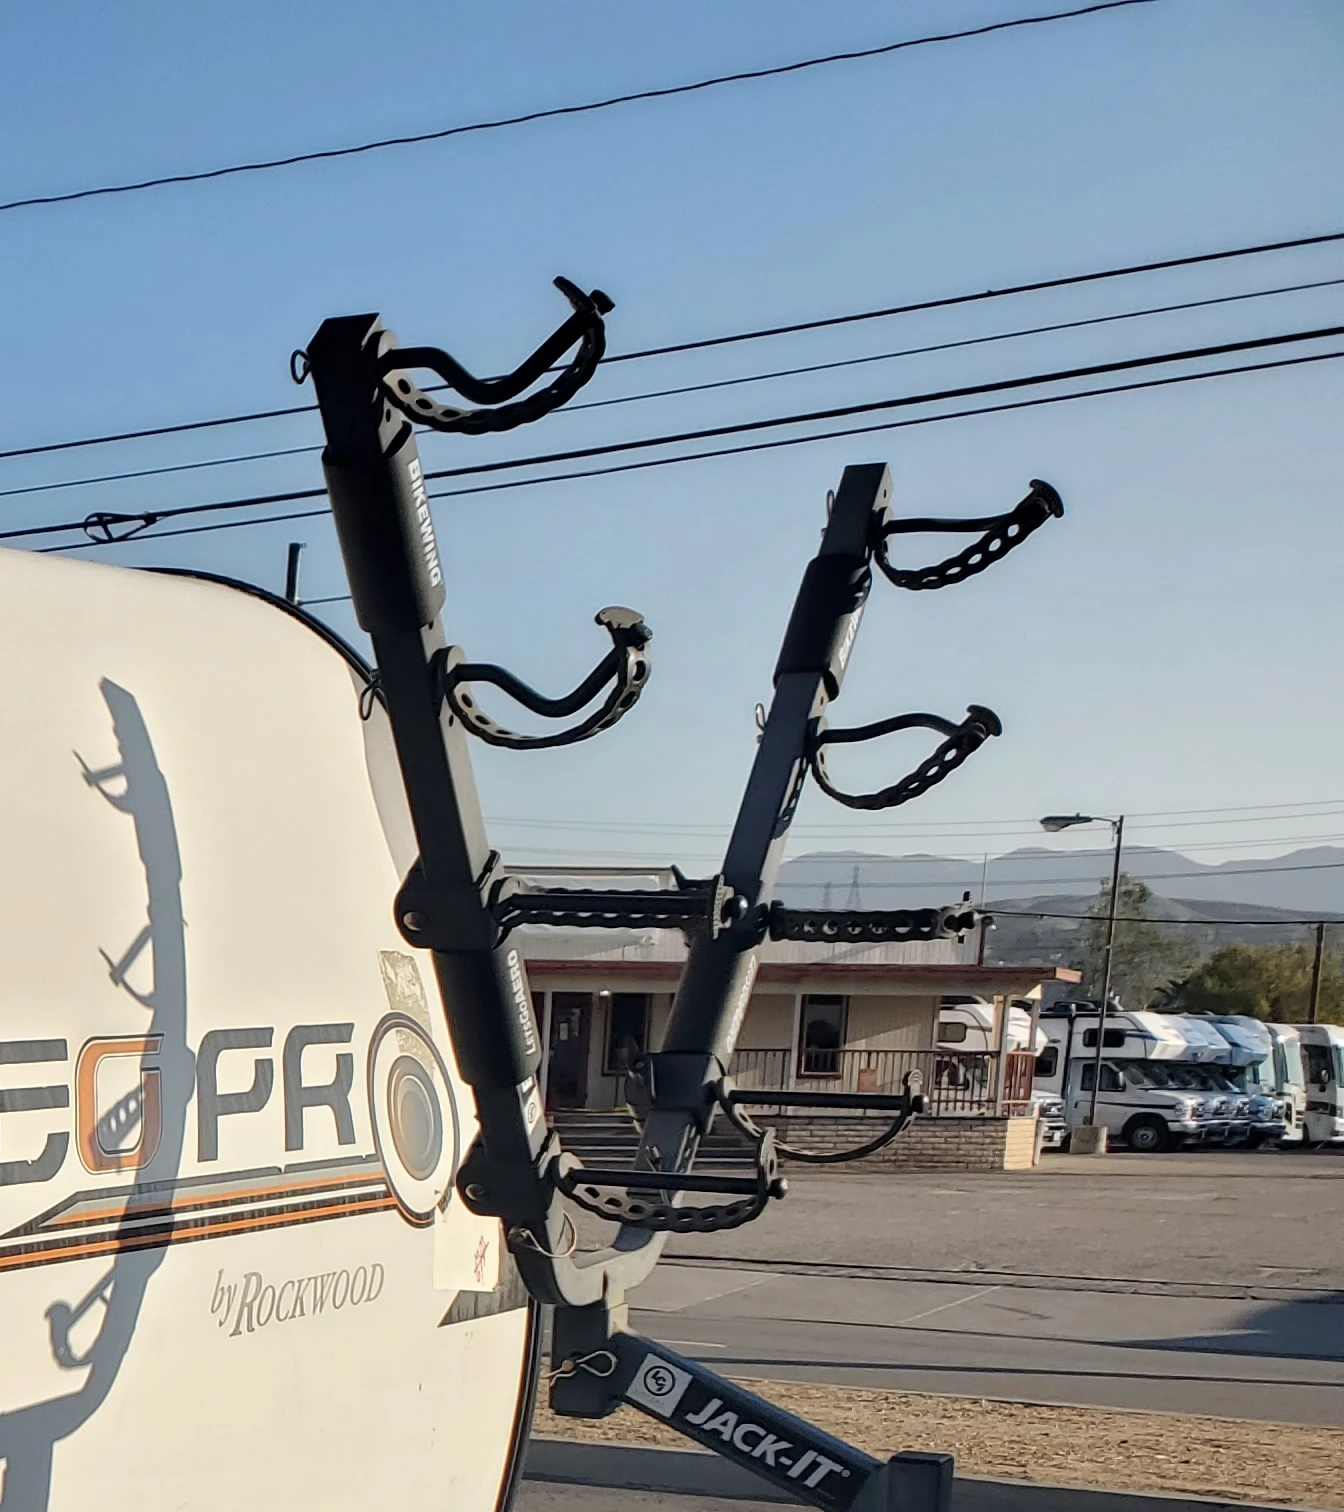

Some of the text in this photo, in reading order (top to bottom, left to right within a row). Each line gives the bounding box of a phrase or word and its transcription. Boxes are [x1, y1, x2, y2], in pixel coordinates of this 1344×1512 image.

[408, 458, 441, 587] BIKEWING
[211, 1263, 385, 1336] by ROCKWOOD
